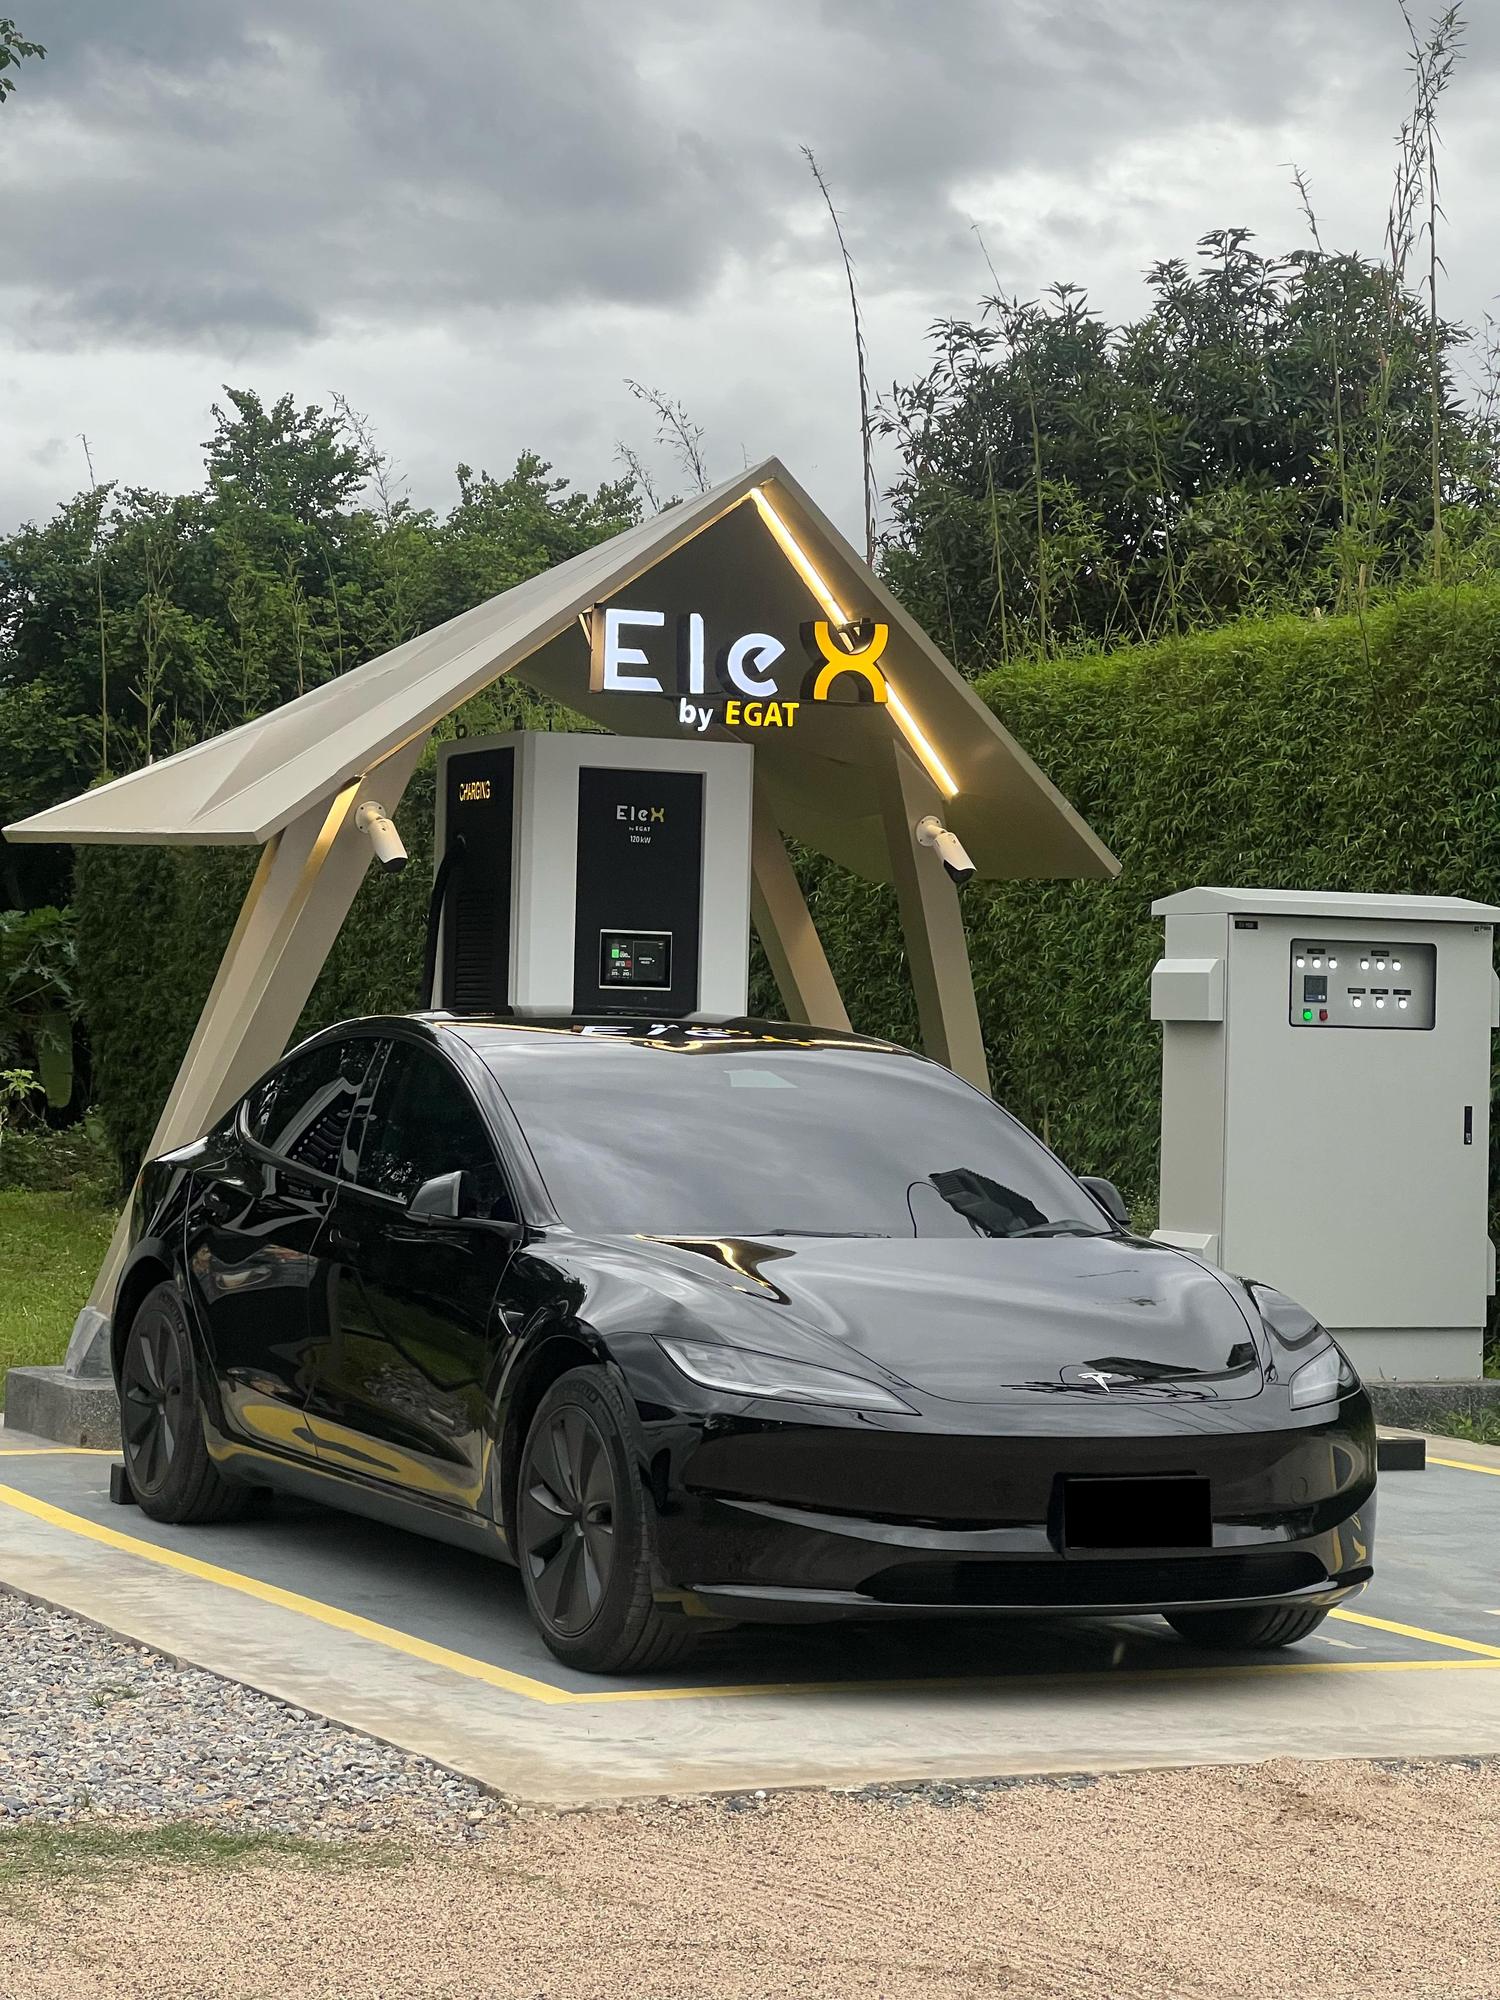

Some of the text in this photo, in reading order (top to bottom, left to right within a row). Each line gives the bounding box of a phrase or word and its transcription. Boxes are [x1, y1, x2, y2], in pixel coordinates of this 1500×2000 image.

[679, 697, 799, 731] by EGAT
[459, 780, 490, 801] CHARGING
